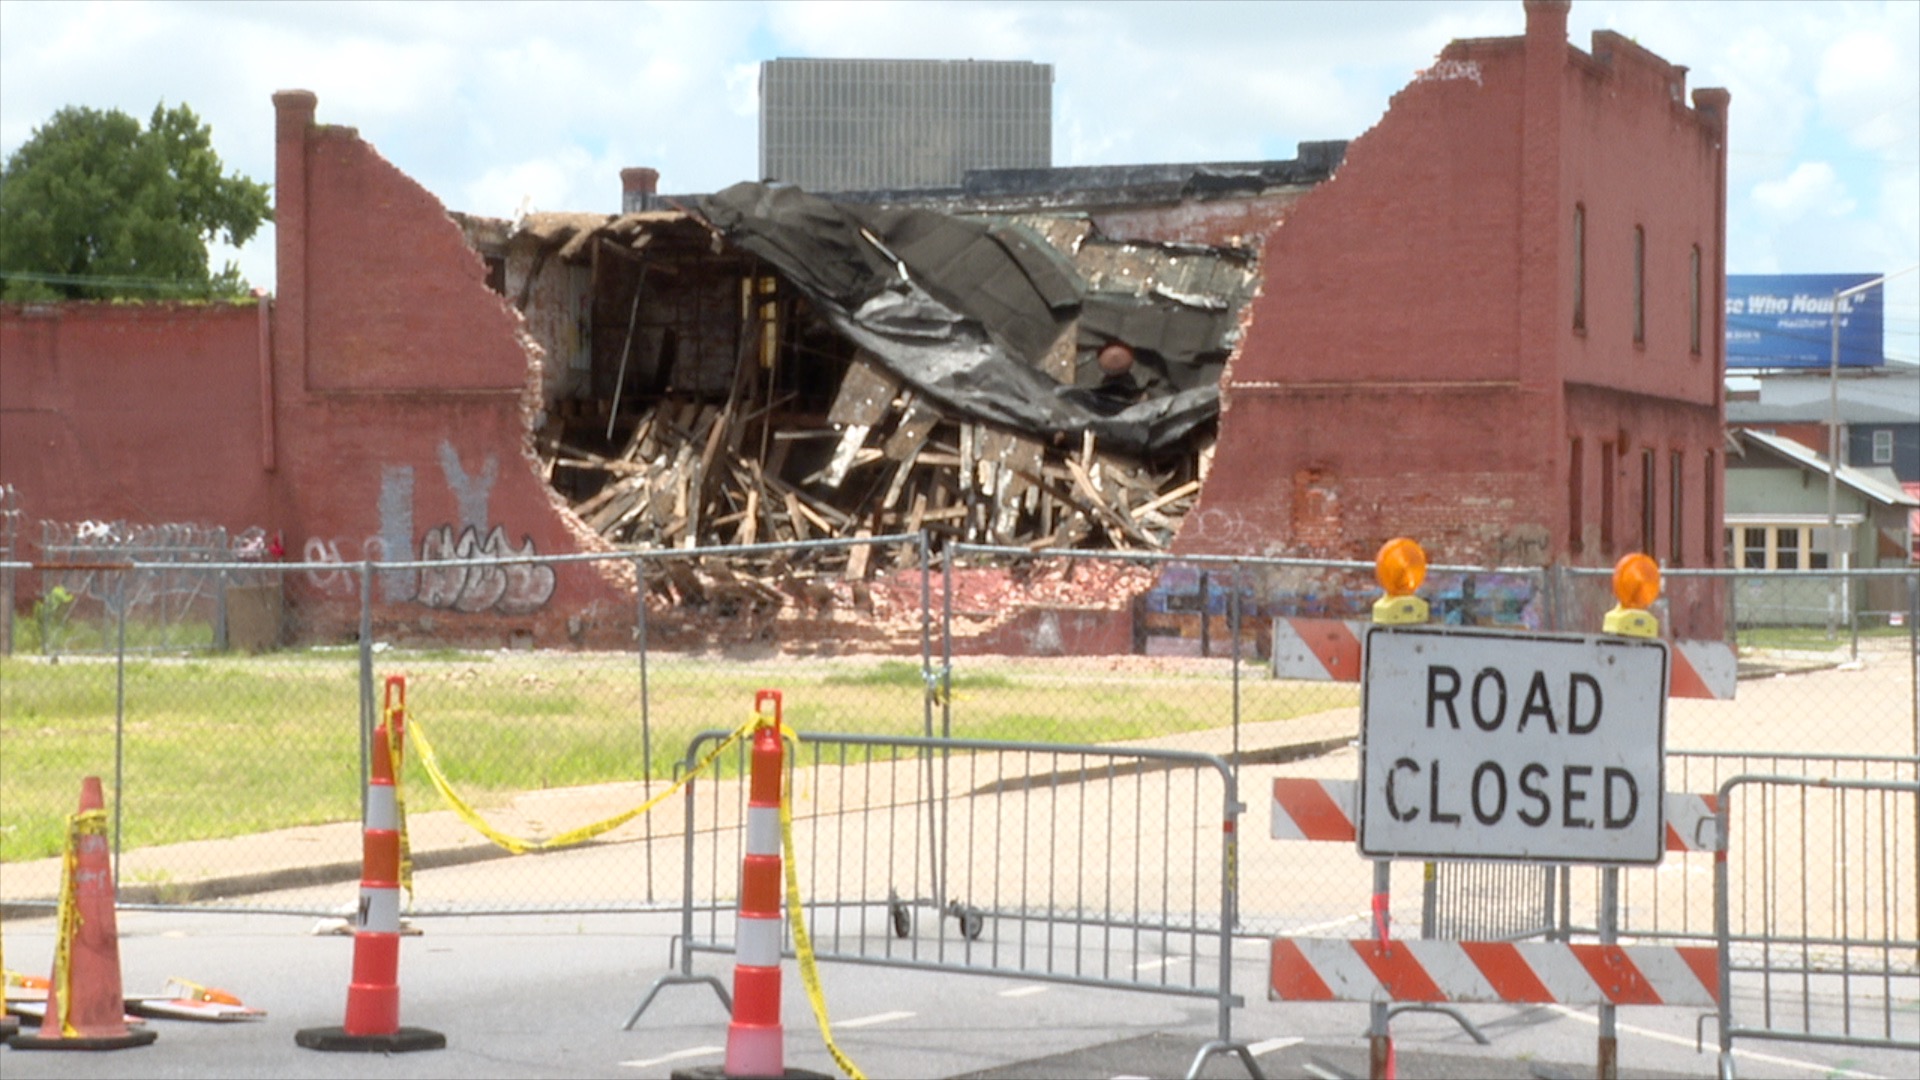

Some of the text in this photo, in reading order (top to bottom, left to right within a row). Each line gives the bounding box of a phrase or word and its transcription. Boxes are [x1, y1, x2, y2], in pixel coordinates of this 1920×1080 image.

[1749, 295, 1789, 314] Who
[1427, 664, 1603, 735] ROAD
[1385, 757, 1639, 830] CLOSED
